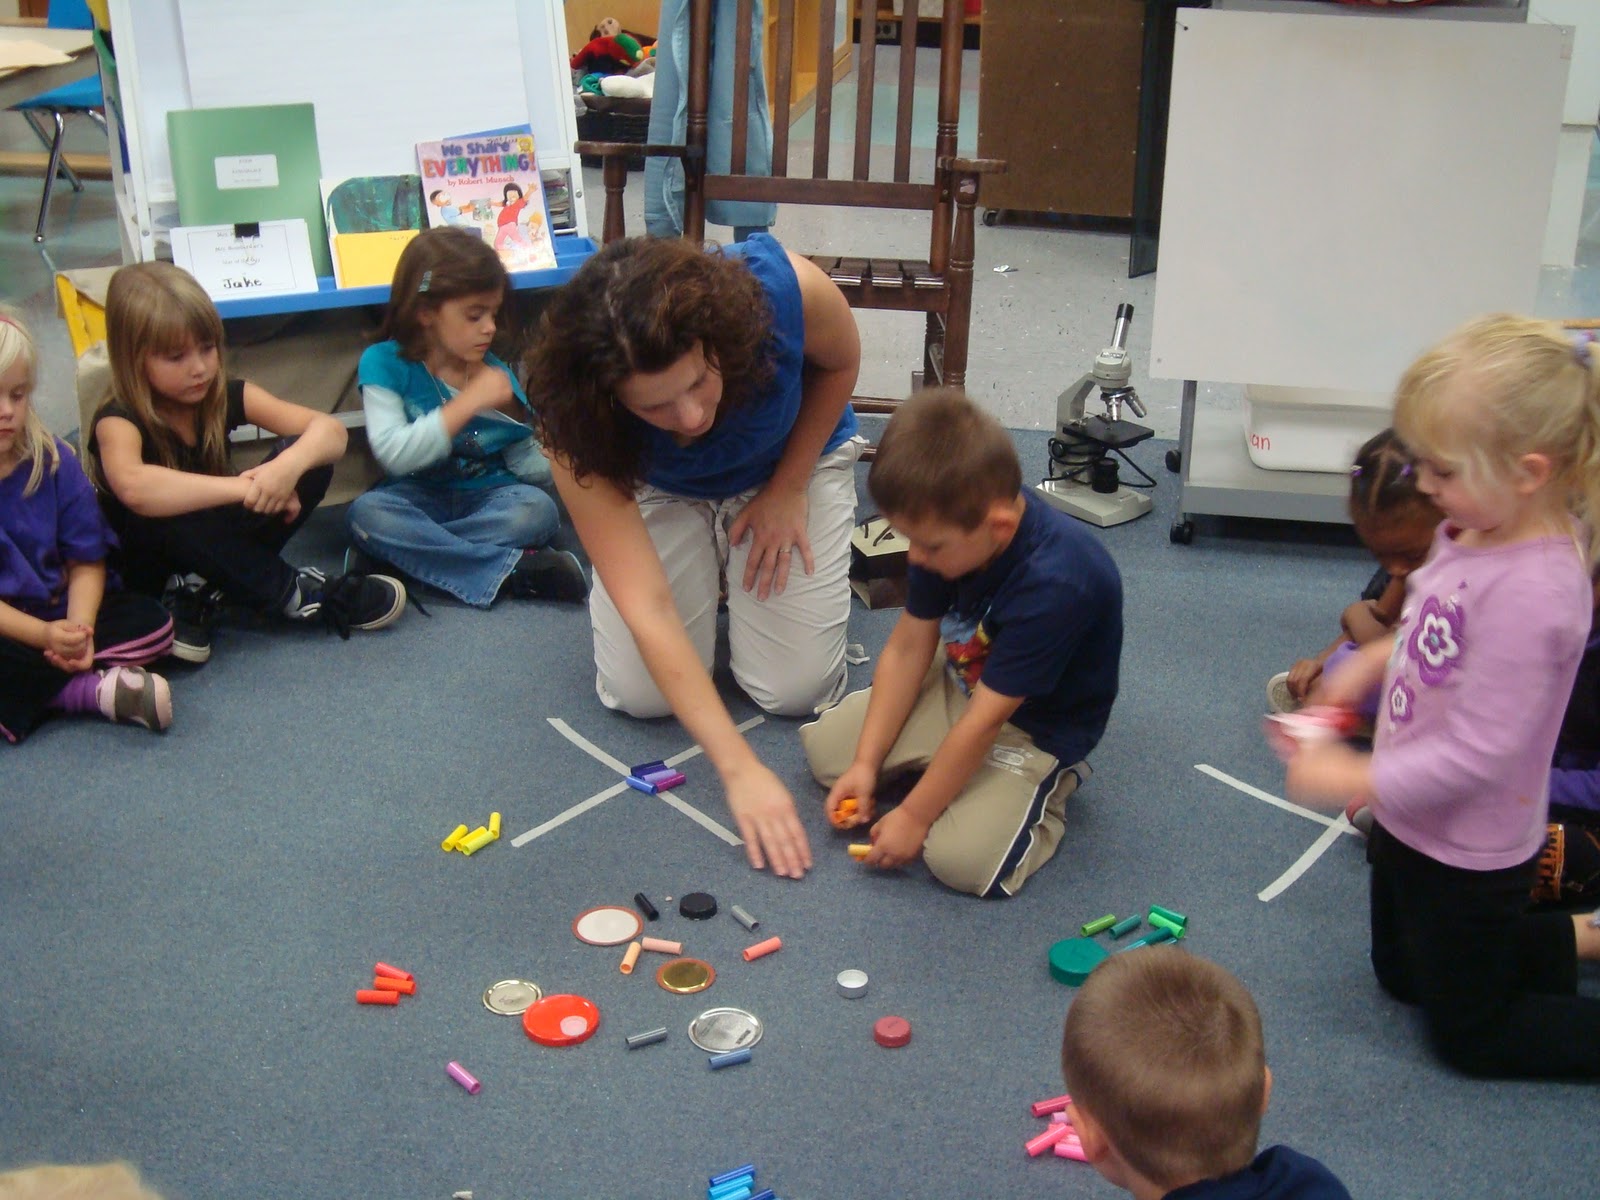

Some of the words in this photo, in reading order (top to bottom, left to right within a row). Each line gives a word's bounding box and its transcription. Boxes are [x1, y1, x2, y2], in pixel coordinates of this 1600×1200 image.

[441, 144, 463, 156] We
[466, 141, 510, 154] Share
[423, 152, 536, 178] EVERYTHING!
[447, 179, 457, 187] by
[458, 176, 483, 186] Robert
[486, 175, 515, 184] Munsch
[223, 276, 262, 289] Jake
